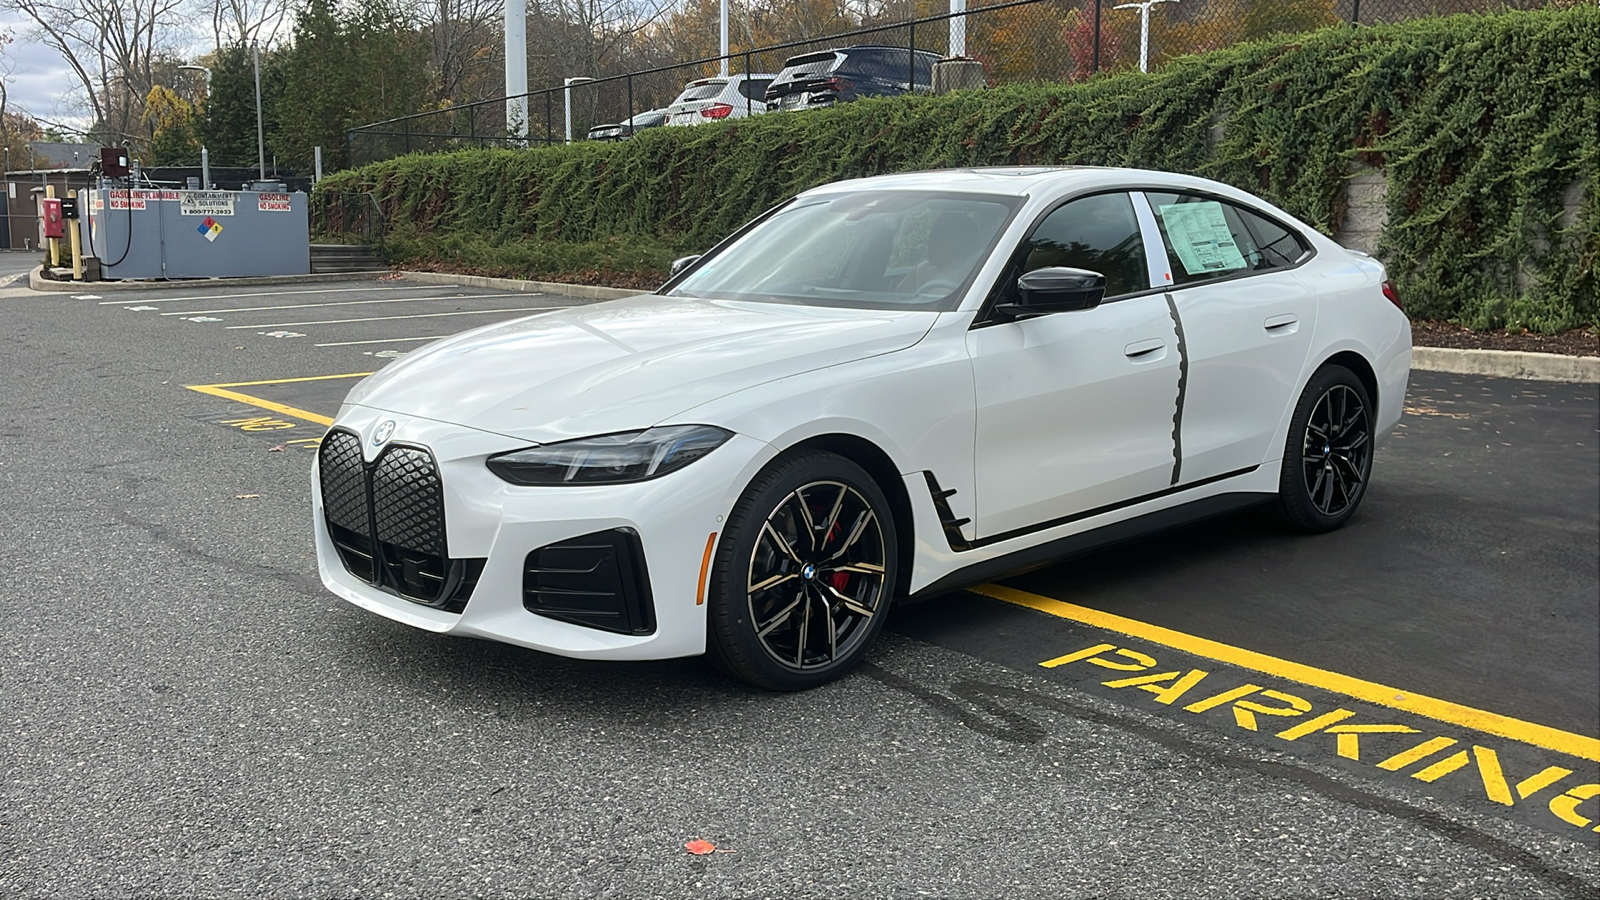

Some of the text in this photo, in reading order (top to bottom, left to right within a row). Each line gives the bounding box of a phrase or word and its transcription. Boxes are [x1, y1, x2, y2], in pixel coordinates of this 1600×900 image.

[259, 193, 290, 201] GASOLINE
[110, 200, 119, 209] NO
[120, 200, 145, 209] SMKING
[267, 202, 290, 211] SMOKING
[220, 416, 296, 431] NO
